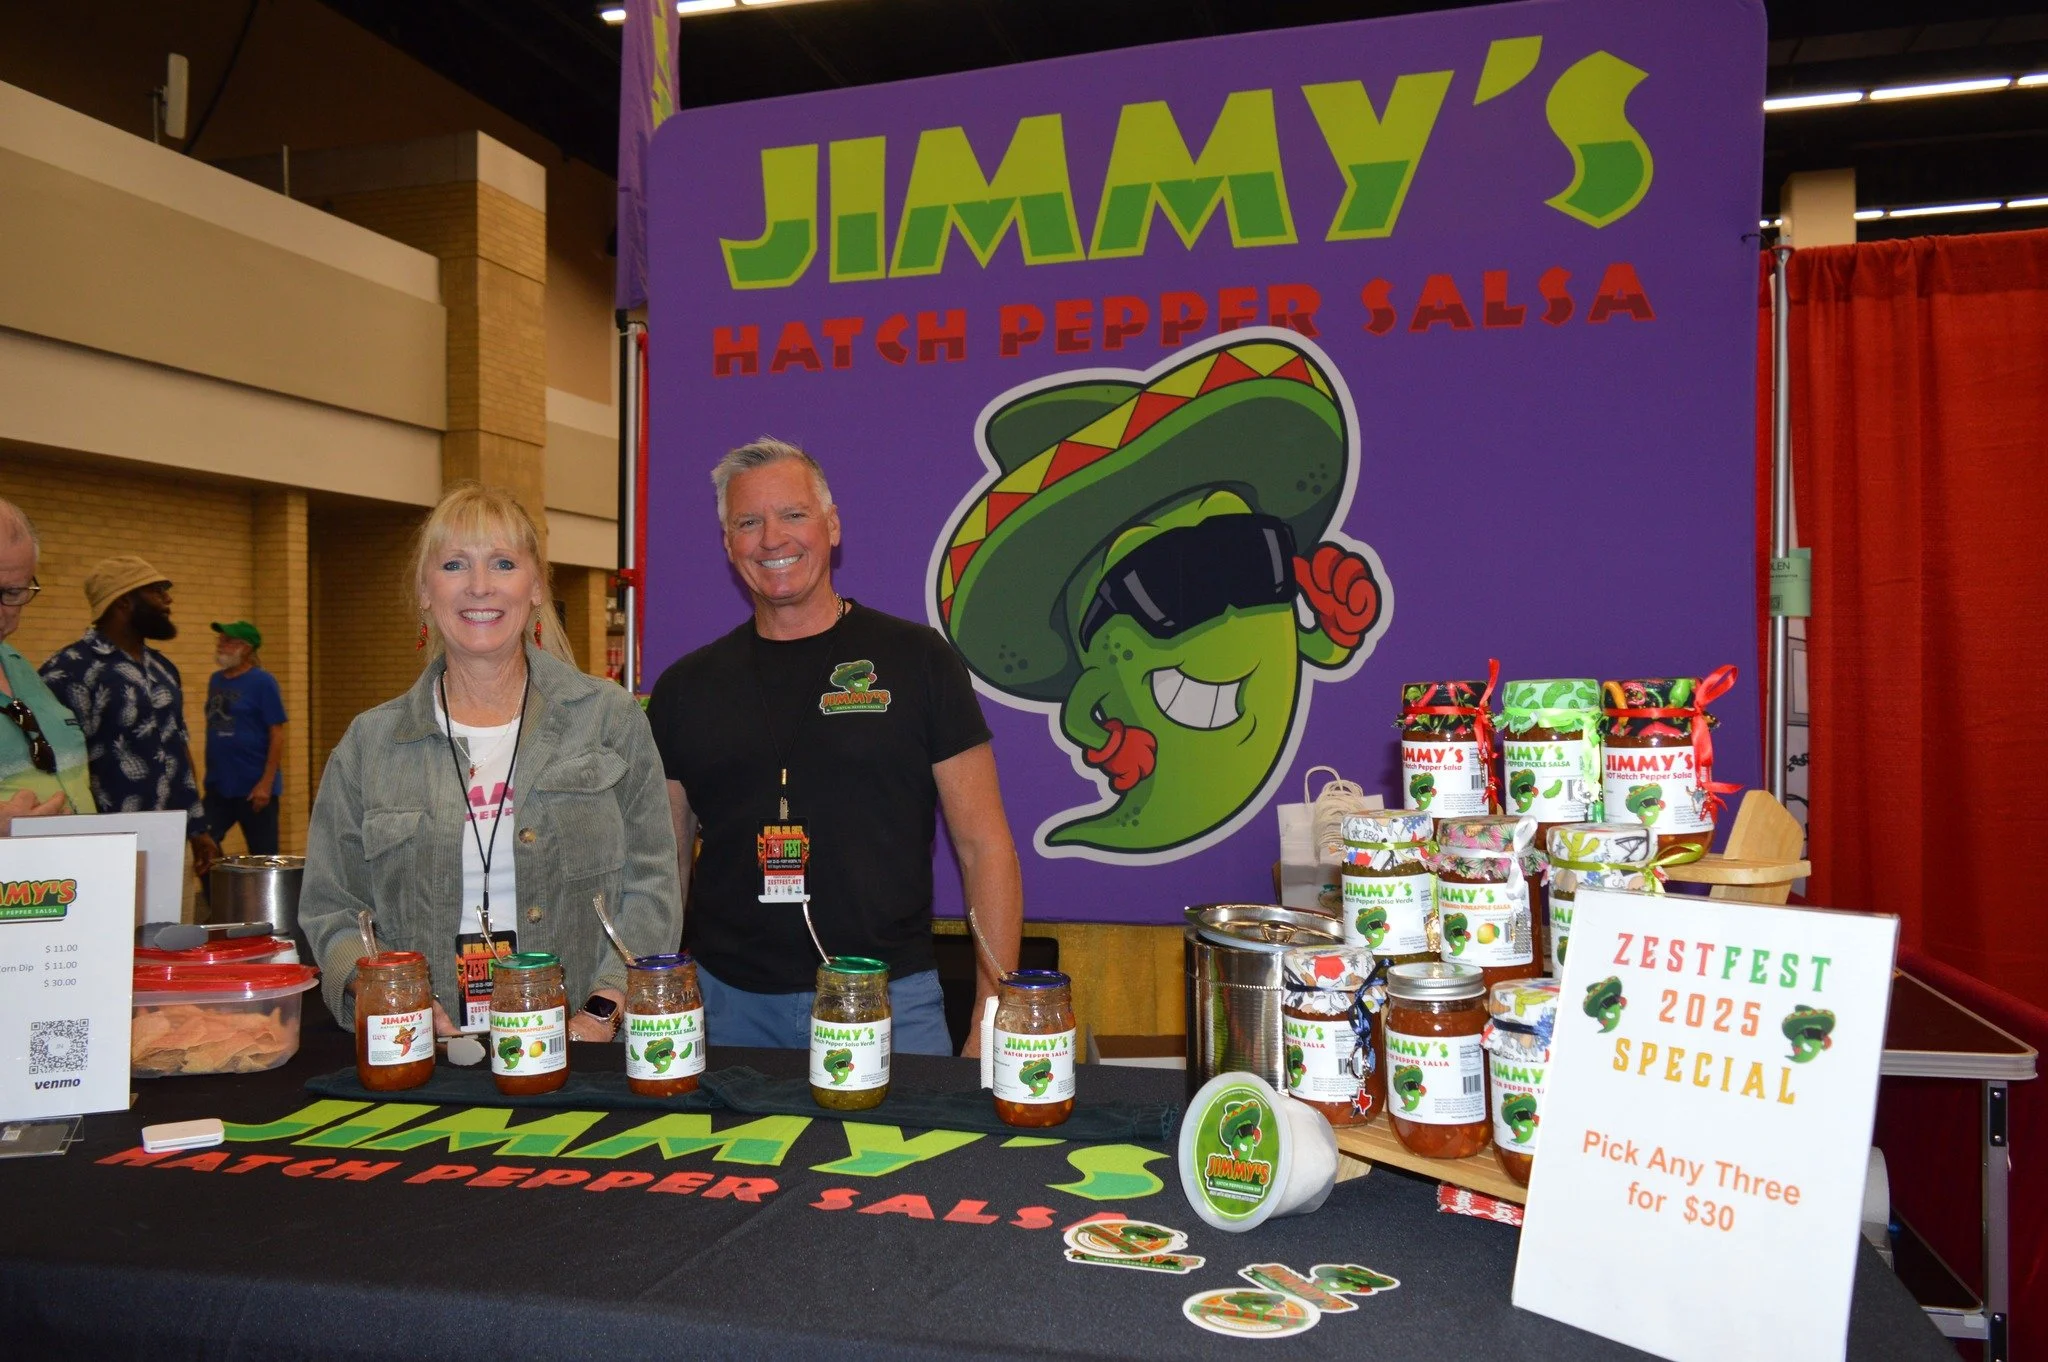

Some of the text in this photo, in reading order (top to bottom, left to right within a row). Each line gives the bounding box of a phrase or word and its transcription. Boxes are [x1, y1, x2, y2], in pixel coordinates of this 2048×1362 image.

[719, 35, 1654, 290] JIMMY'S
[712, 262, 1656, 378] HATCH PEPPER SALSA
[822, 691, 889, 707] JIMMY'S
[1418, 763, 1442, 771] Pepper
[1606, 751, 1694, 772] JIMMY'S
[1616, 772, 1638, 780] Hatch
[1639, 773, 1671, 781] Pepper
[1672, 772, 1692, 780] Salsa
[1345, 881, 1413, 897] JIMMY'S
[54, 944, 78, 953] 11.00
[19, 964, 34, 972] Dip
[53, 961, 78, 970] 11.00
[1612, 932, 1832, 992] ZESTFEST
[52, 978, 77, 987] 30.00
[381, 1013, 423, 1025] JIMMY'S
[1658, 989, 1761, 1037] 2025
[630, 1014, 694, 1032] JIMMY'S
[814, 1025, 875, 1041] JIMMY'S
[825, 1040, 844, 1048] Pepper
[1004, 1036, 1069, 1052] JIMMY'S
[1003, 1050, 1023, 1058] HATCH
[1612, 1037, 1796, 1105] SPECIAL
[34, 1077, 82, 1091] venmo
[222, 1099, 1172, 1201] JIMMY'S
[93, 1147, 404, 1183] HATCH
[402, 1162, 780, 1203] PEPPER
[1207, 1156, 1270, 1185] JIMMY'S
[1581, 1129, 1801, 1206] Pick Any Three
[1627, 1181, 1735, 1233] for $30
